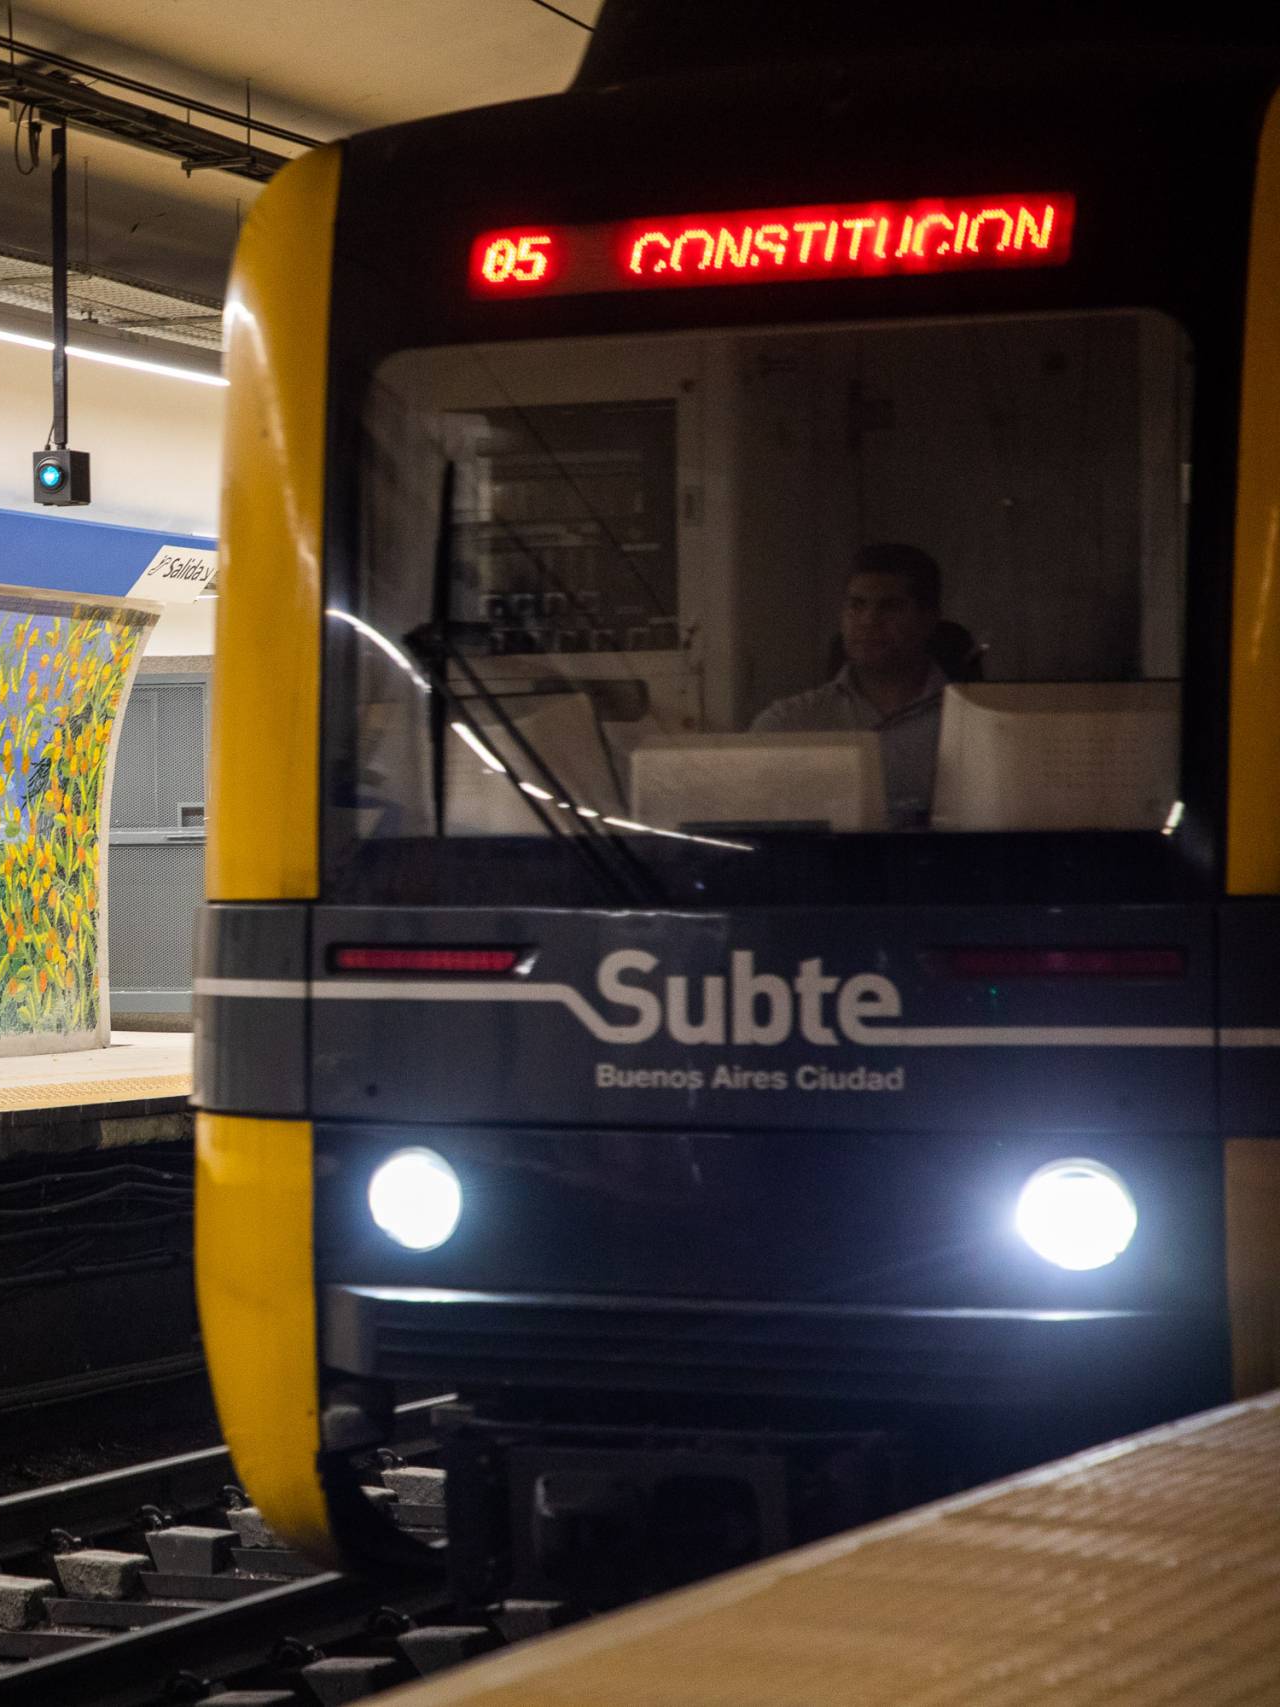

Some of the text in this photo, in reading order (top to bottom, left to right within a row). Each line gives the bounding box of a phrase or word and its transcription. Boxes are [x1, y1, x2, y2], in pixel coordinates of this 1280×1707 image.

[481, 205, 1055, 284] 05 CONSTITUCION
[163, 557, 205, 581] Salida
[597, 948, 903, 1046] Subte
[596, 1063, 906, 1092] Buenos Aires Ciudad
